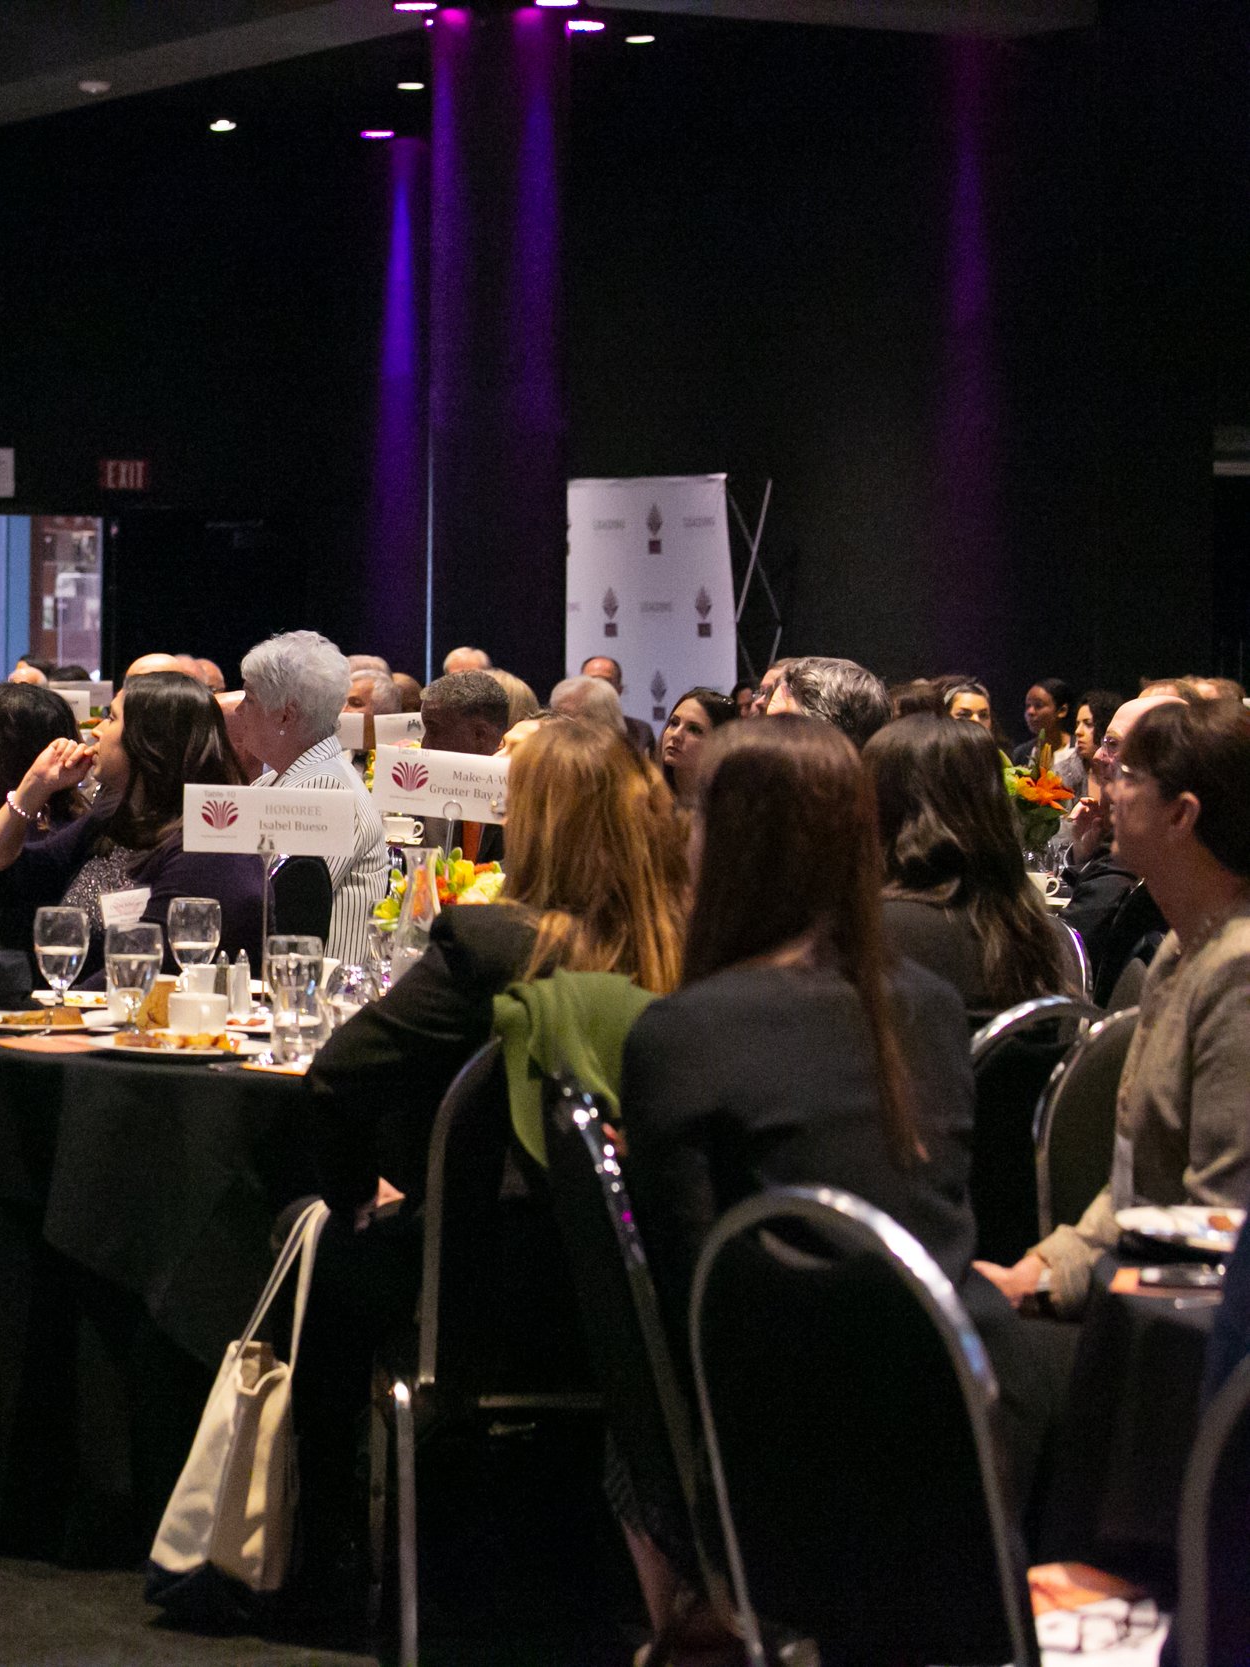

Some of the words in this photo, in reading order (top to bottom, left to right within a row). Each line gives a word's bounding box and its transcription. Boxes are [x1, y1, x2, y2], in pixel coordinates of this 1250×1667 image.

[107, 460, 144, 489] EXIT
[204, 790, 224, 798] Table
[227, 790, 237, 798] 10
[429, 783, 471, 798] Greater
[473, 788, 494, 801] Bay
[265, 804, 322, 817] HONOREE
[259, 819, 291, 831] Isabel
[295, 820, 328, 832] Bueso
